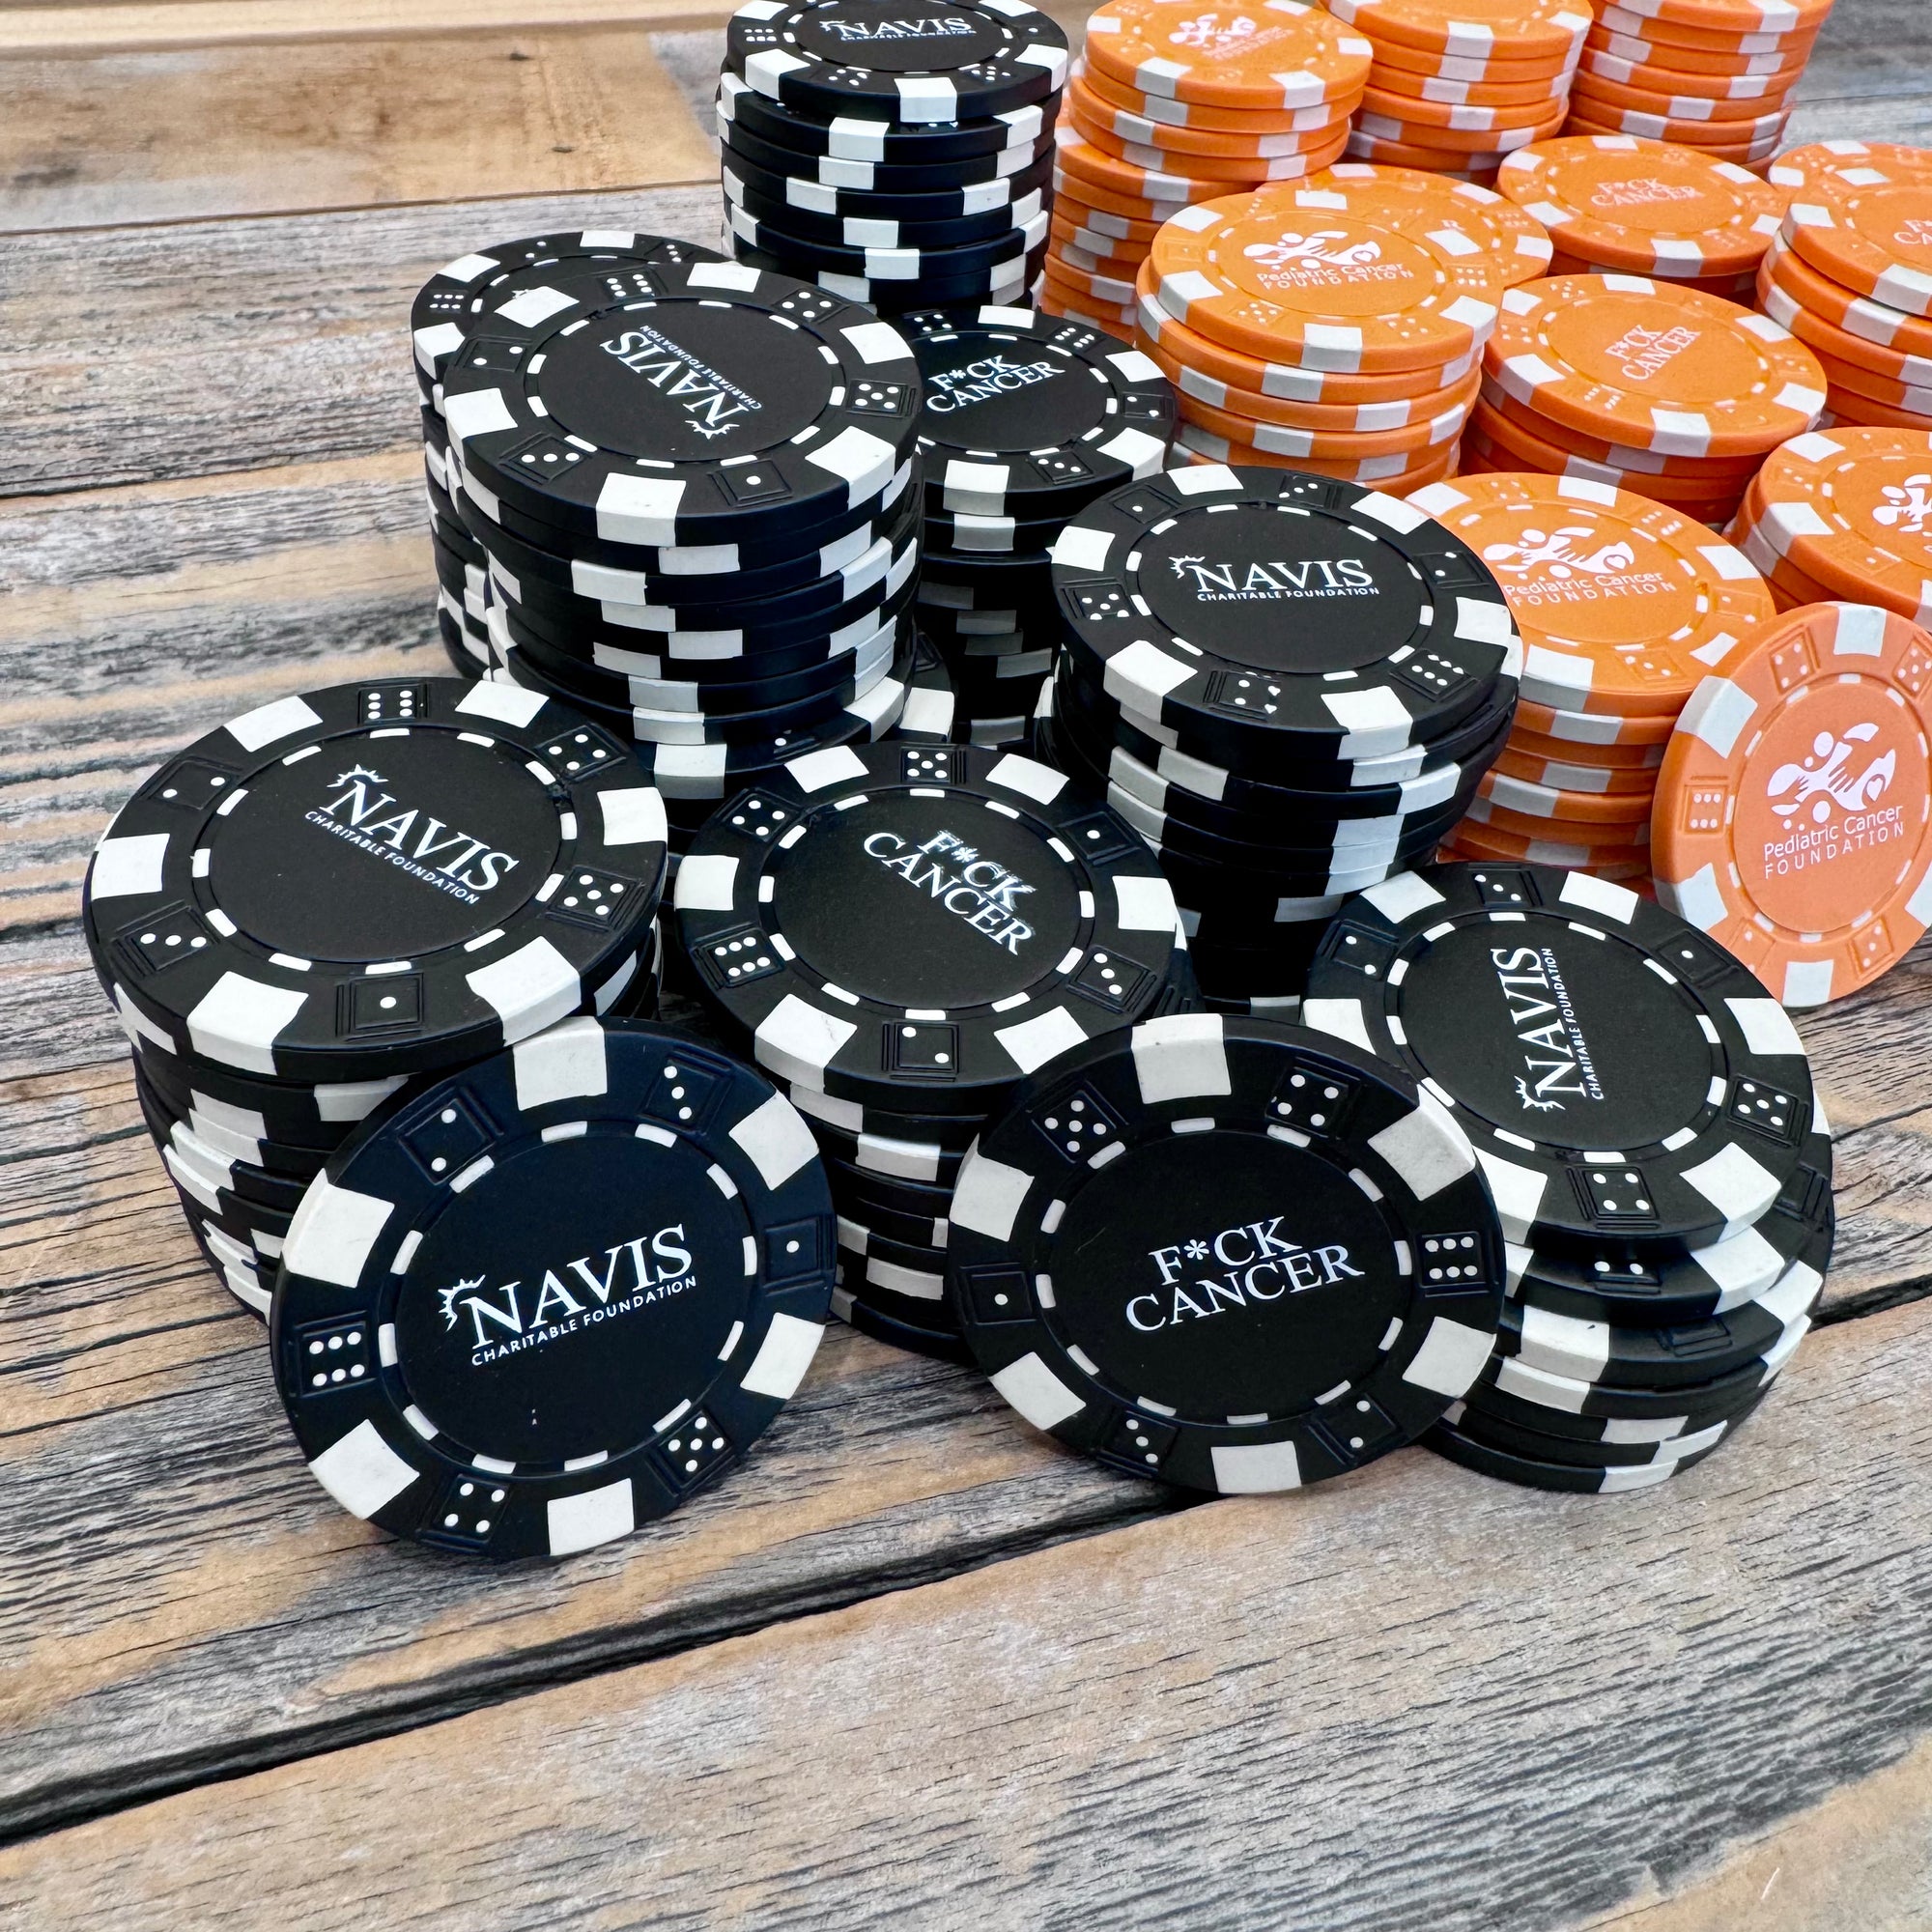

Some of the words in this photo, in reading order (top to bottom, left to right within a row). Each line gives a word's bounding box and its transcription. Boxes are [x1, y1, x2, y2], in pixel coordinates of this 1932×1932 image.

[833, 17, 972, 38] NAVIS
[1590, 185, 1706, 206] CANCER
[1263, 270, 1415, 290] FOUNDATION
[1341, 264, 1405, 275] Cancer
[639, 325, 704, 371] FOUNDATION
[1622, 327, 1702, 381] CANCER
[599, 331, 750, 427] NAVIS
[702, 367, 763, 411] CHARITABLE
[926, 361, 1066, 412] CANCER
[1186, 559, 1374, 592] NAVIS
[1197, 589, 1282, 602] CHARITABLE
[1286, 586, 1380, 599] FOUNDATION
[1503, 577, 1593, 597] Pediatric
[1595, 572, 1663, 587] Cancer
[1512, 582, 1677, 608] FOUNDATION
[304, 810, 386, 860] CHARITABLE
[384, 851, 480, 905] FOUNDATION
[318, 780, 520, 891] NAVIS
[1764, 825, 1839, 862] Pediatric
[1843, 805, 1904, 835] Cancer
[1765, 822, 1904, 880] FOUNDATION
[864, 832, 1036, 956] CANCER
[1541, 948, 1577, 1024] FOUNDATION
[1490, 947, 1587, 1098] NAVIS
[1568, 1027, 1605, 1100] CHARITABLE
[459, 1223, 693, 1350] NAVIS
[1125, 1244, 1366, 1332] CANCER
[471, 1320, 578, 1367] CHARITABLE
[582, 1275, 697, 1326] FOUNDATION
